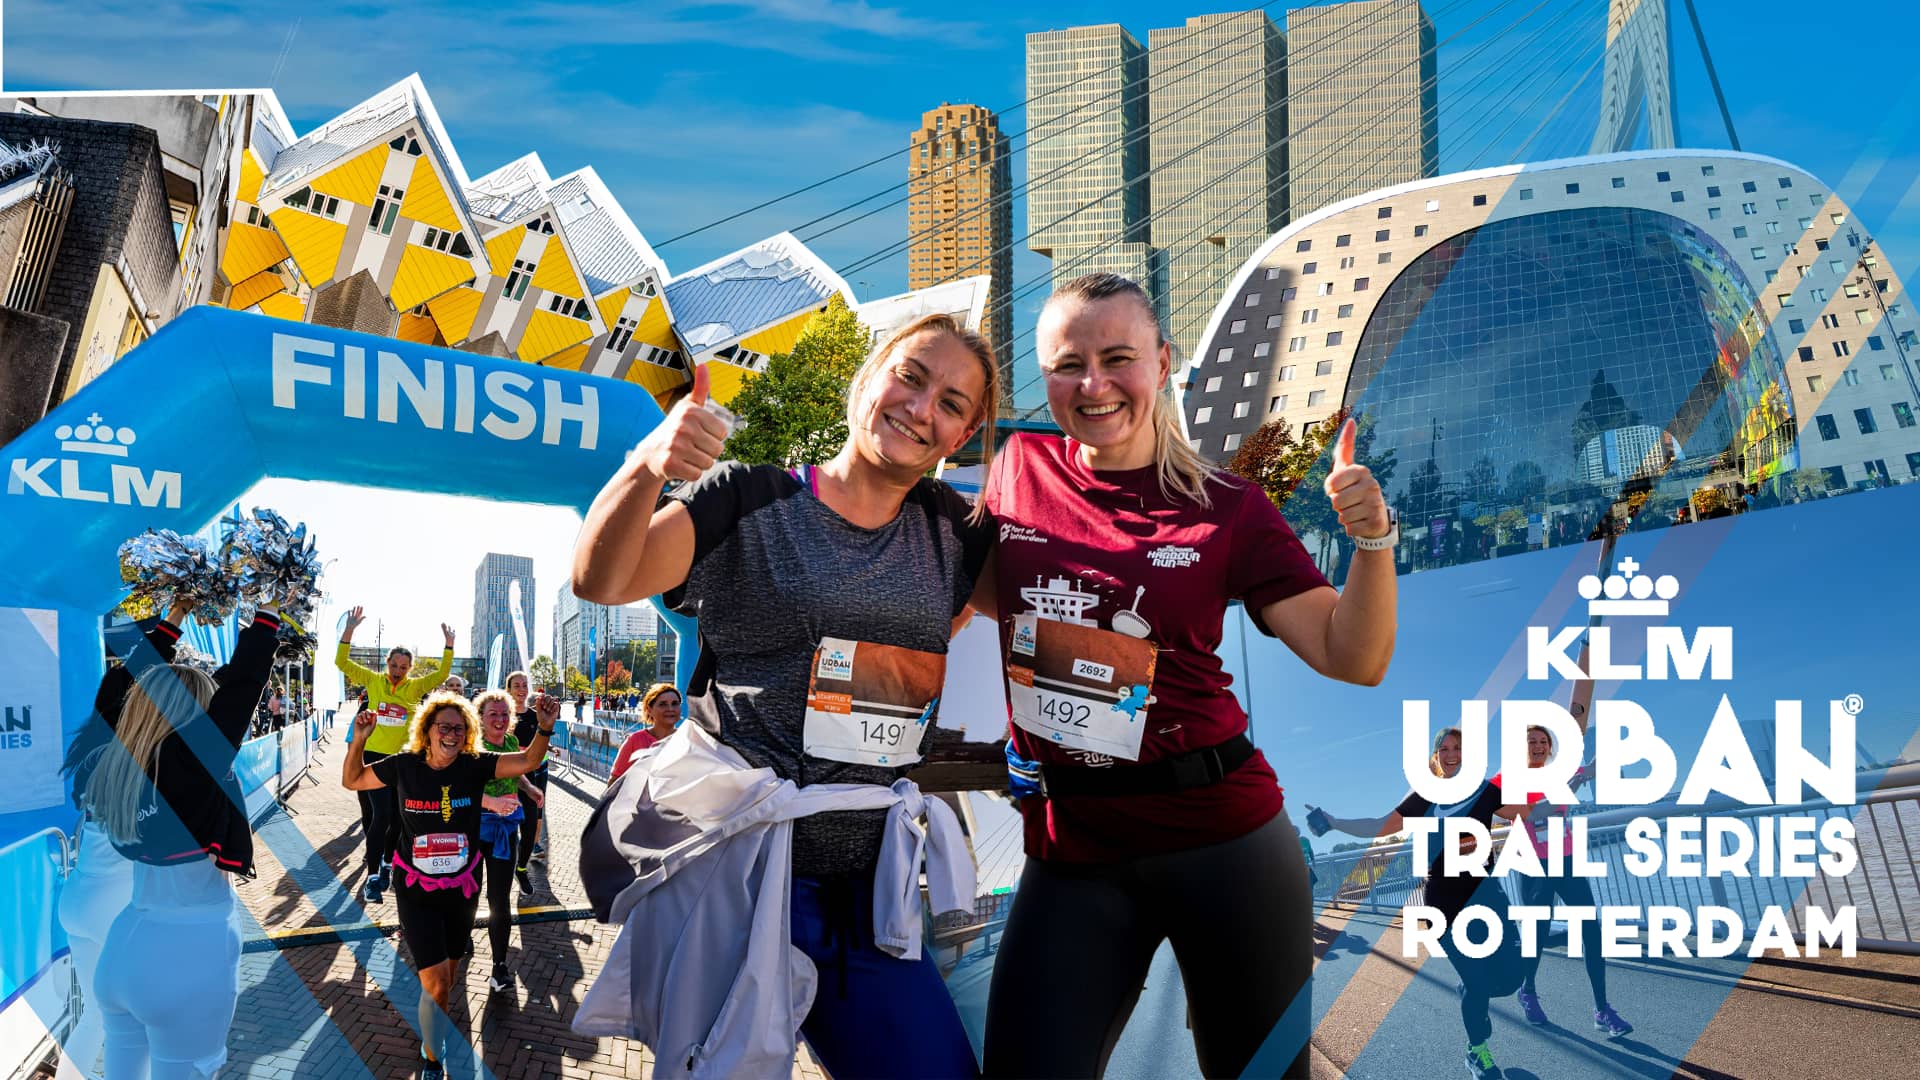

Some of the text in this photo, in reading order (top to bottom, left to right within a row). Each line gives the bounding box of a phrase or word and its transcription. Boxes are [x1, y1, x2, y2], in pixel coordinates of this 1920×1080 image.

[271, 332, 600, 451] FINISH
[7, 457, 183, 509] KLM
[1080, 663, 1107, 678] 2692
[1037, 695, 1091, 729] 1492
[405, 799, 440, 810] URBAN
[451, 797, 472, 808] RUN
[432, 857, 451, 867] 636
